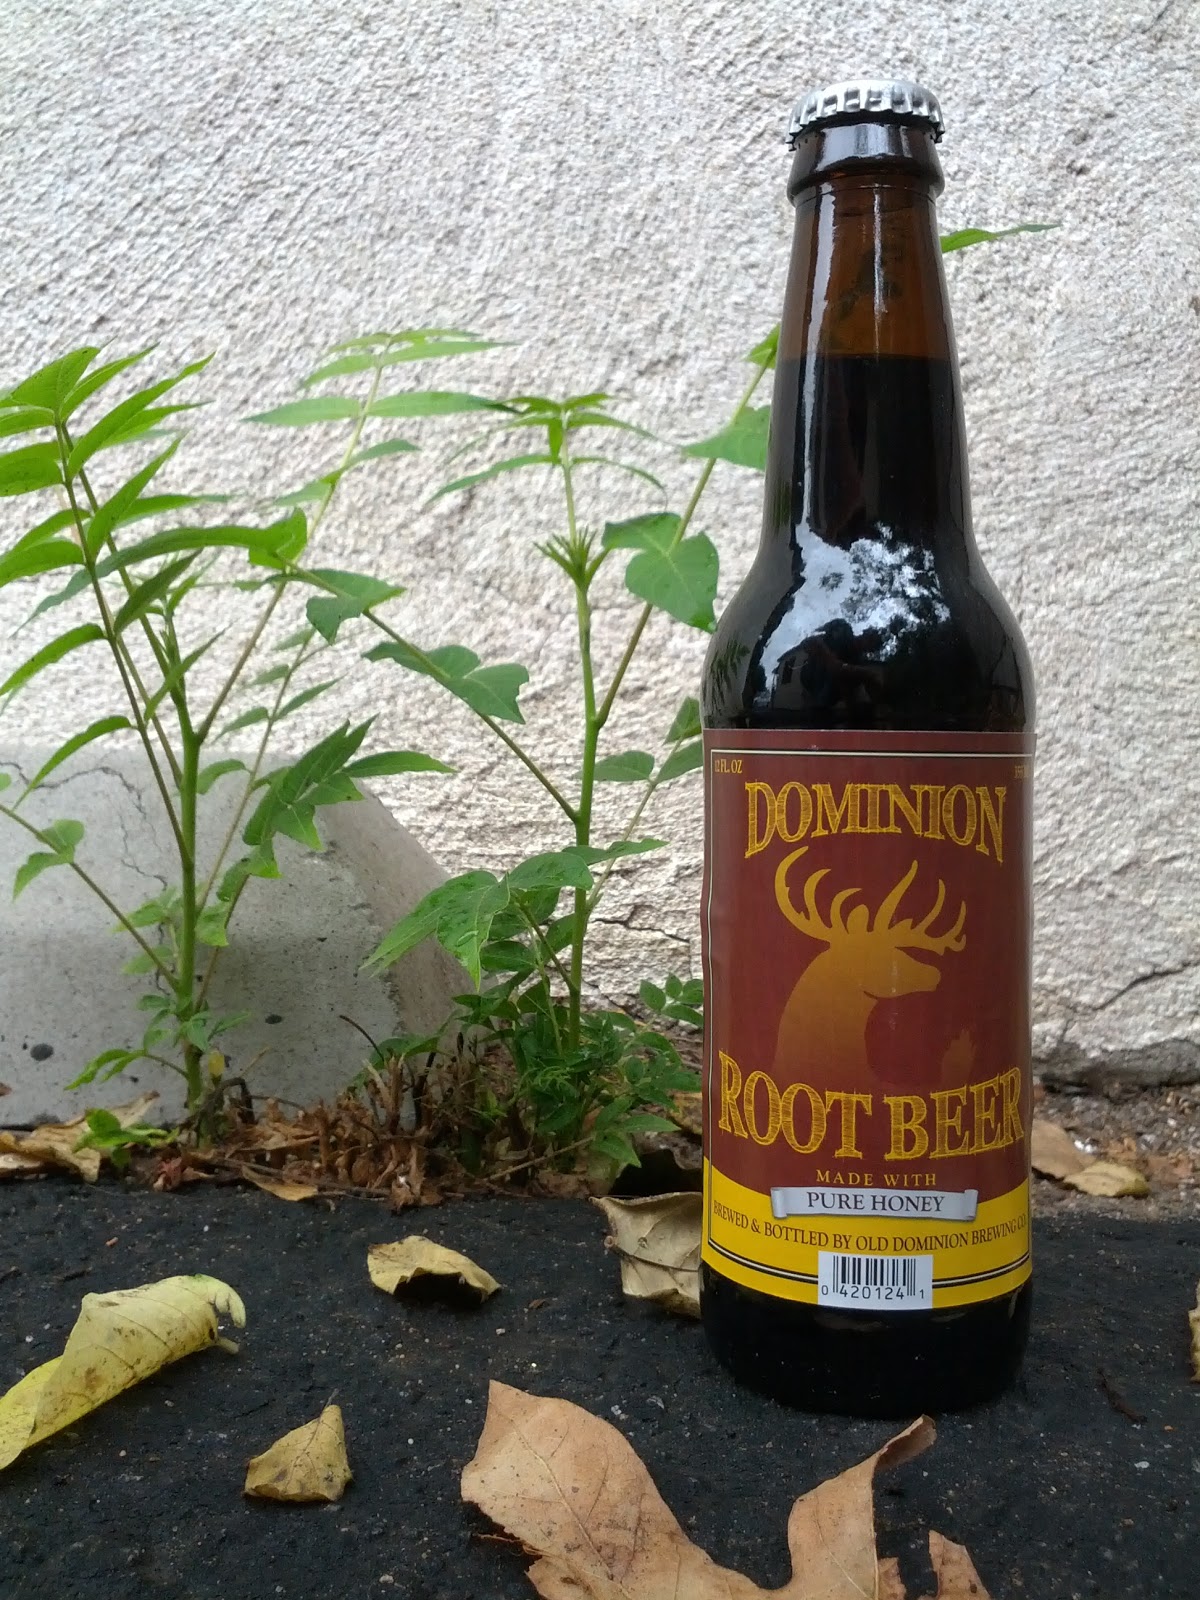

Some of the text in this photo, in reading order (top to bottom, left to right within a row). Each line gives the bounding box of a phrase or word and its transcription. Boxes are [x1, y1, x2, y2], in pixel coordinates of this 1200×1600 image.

[731, 760, 743, 774] OZ
[744, 781, 1007, 862] DOMINION
[718, 1049, 1025, 1160] ROOT BEER
[816, 1169, 937, 1187] MADE WITH
[807, 1191, 946, 1212] PURE HONEY
[713, 1200, 749, 1229] BREWED
[750, 1219, 761, 1234] &
[764, 1221, 829, 1247] BOTTLED
[833, 1233, 851, 1250] BY
[855, 1235, 889, 1251] OLD
[893, 1231, 969, 1252] DOMINION
[971, 1219, 1017, 1246] BREWING
